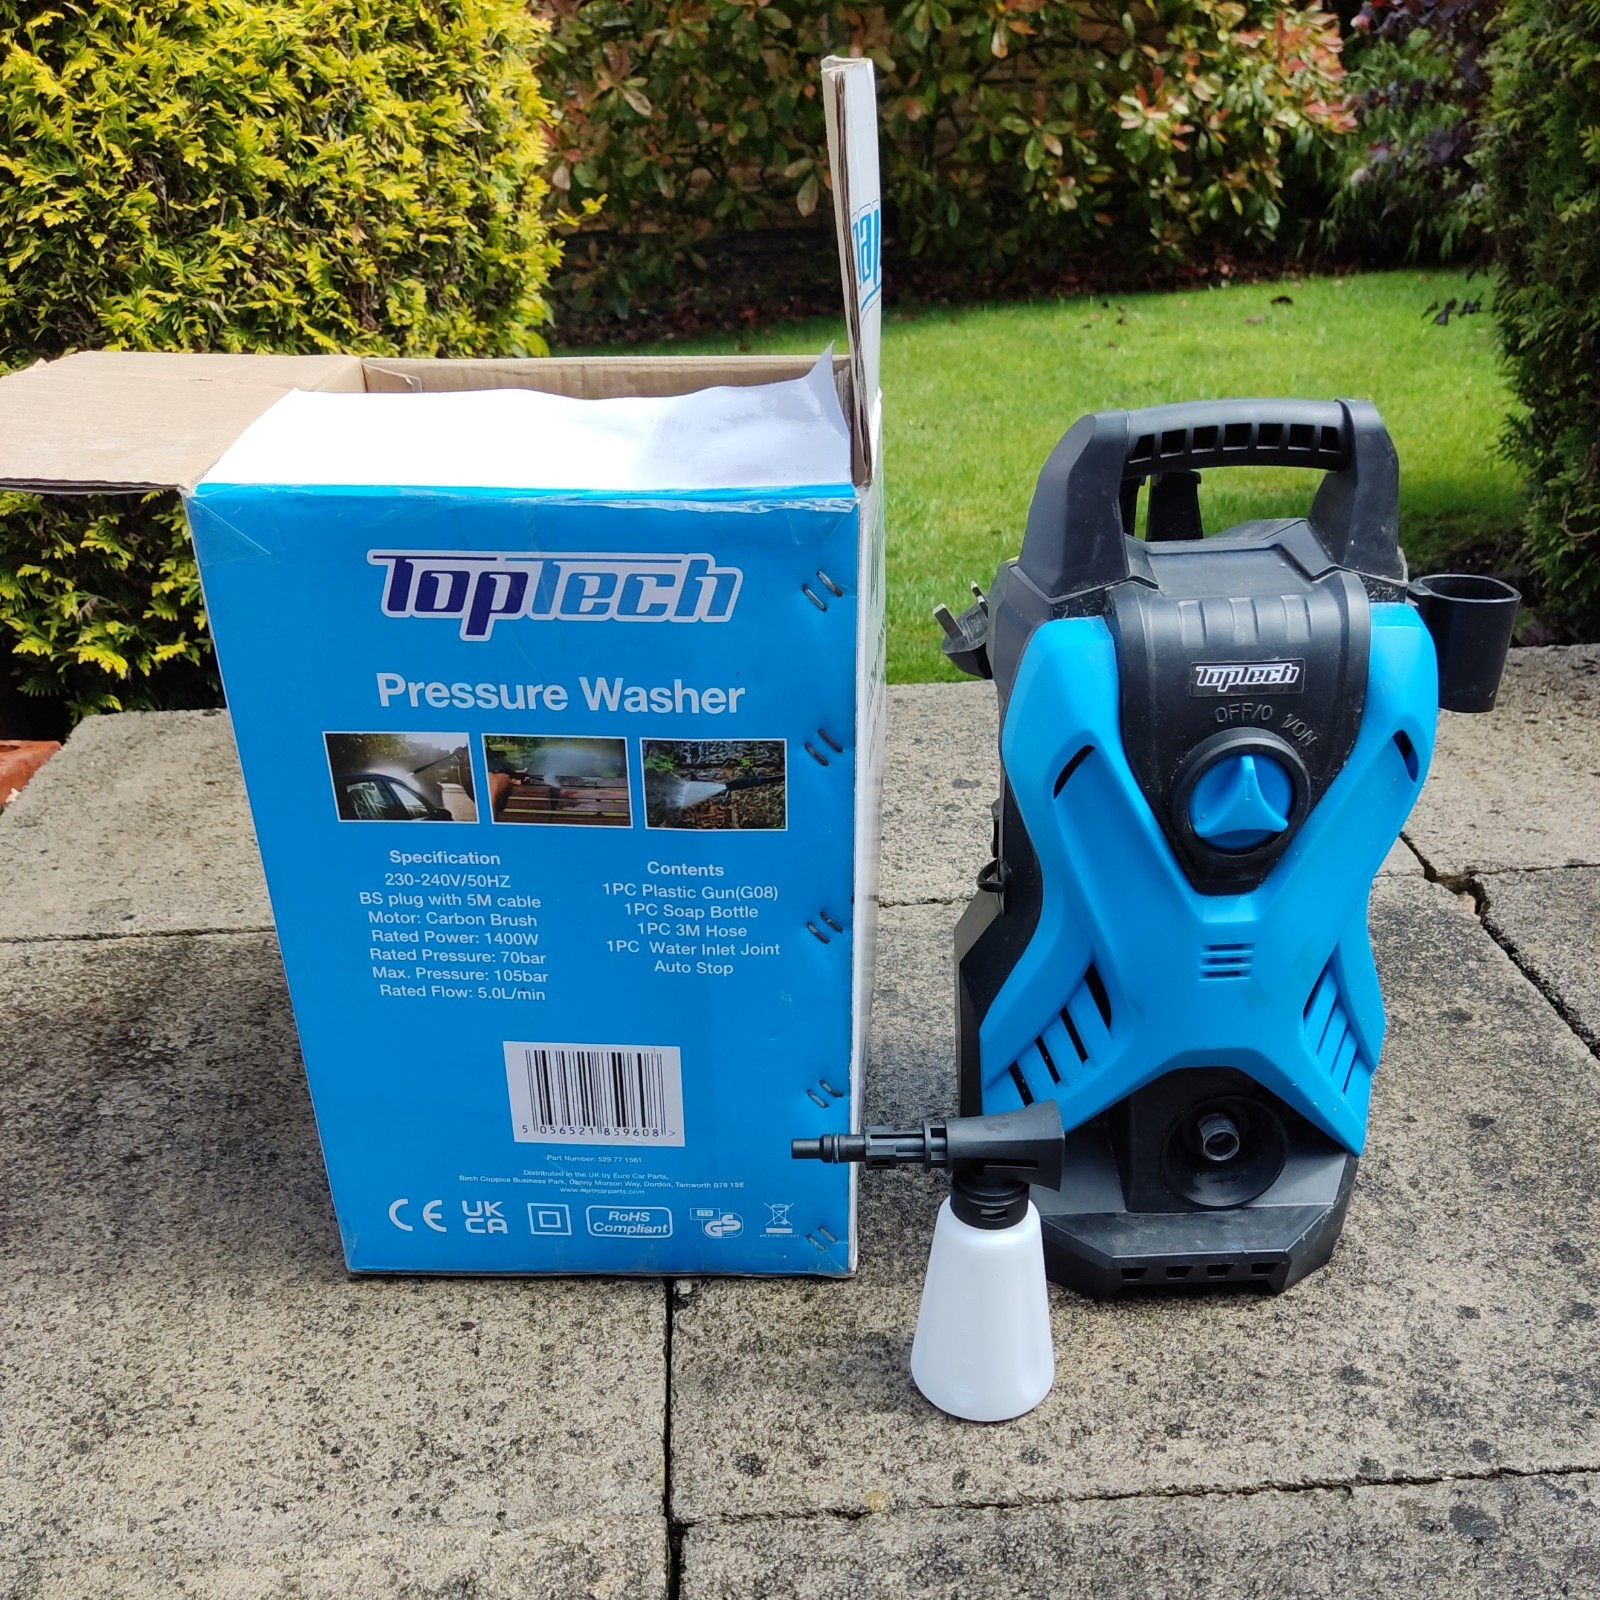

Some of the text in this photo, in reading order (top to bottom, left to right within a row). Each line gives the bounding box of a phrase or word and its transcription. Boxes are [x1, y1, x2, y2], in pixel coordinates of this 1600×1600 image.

[376, 672, 746, 714] Pressure Washer
[389, 850, 500, 866] Specification
[647, 861, 724, 876] Contents
[384, 873, 511, 888] 230-240V/50HZ
[359, 891, 541, 908] BS plug with 5M cable
[602, 882, 778, 901] 1PC Plastic Gun(G08)
[368, 911, 538, 927] Motor: Carbon Brush
[624, 902, 759, 921] 1PC Soap Bottle
[371, 930, 539, 946] Rated Power: 1400W
[637, 922, 748, 938] 1PC 3M Hose
[606, 940, 780, 956] 1PC Water Inlet Joint
[369, 948, 546, 965] Rated Pressure: 70bar
[372, 966, 549, 983] Max. Pressure: 105bar
[654, 960, 734, 976] Auto Stop
[380, 984, 545, 1000] Rated Flow: 5.0L/min
[523, 1169, 564, 1177] Distributed
[512, 1176, 546, 1184] Business
[624, 1180, 642, 1188] Way,
[388, 1198, 447, 1233] CE
[608, 1211, 651, 1223] RoHS
[593, 1221, 669, 1235] Compliant
